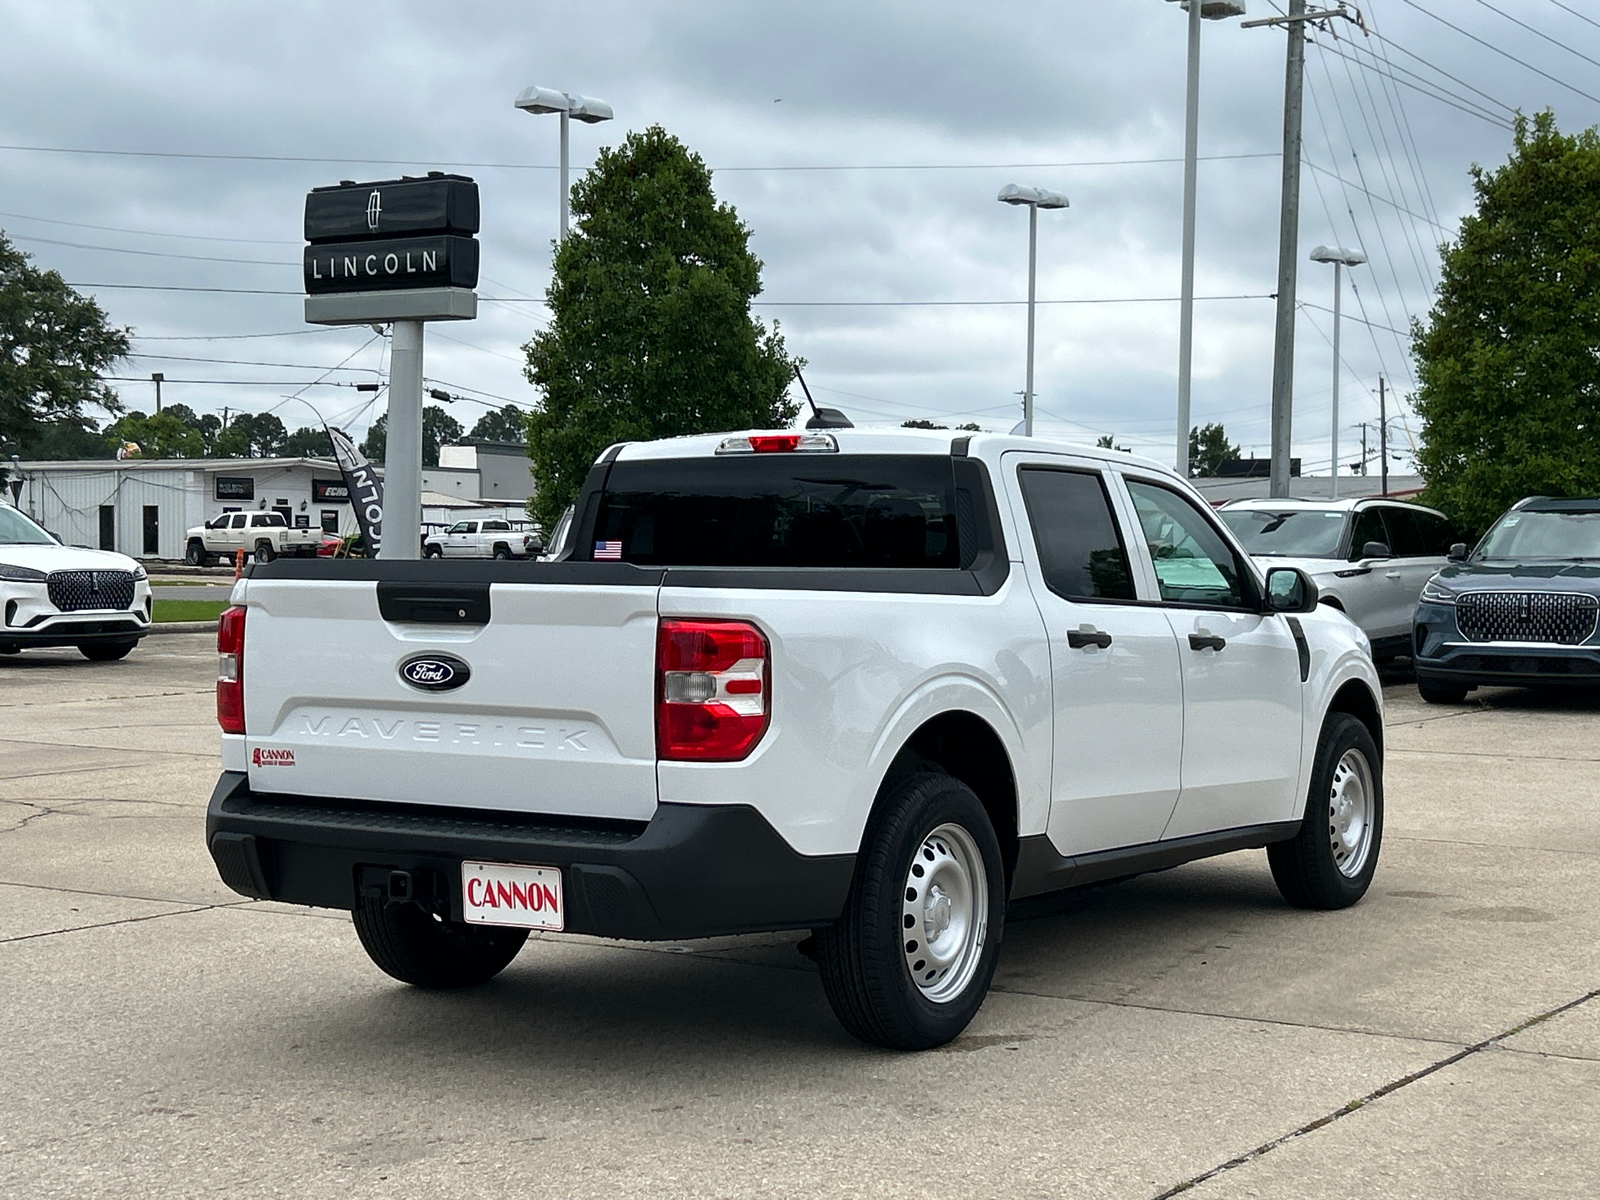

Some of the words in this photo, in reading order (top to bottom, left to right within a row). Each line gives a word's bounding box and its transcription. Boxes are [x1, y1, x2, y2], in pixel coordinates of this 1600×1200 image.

[313, 250, 437, 279] LINCOLN
[412, 663, 444, 681] Ford
[300, 714, 589, 751] MAVERICK
[262, 749, 295, 760] CANNON
[467, 877, 559, 914] CANNON
